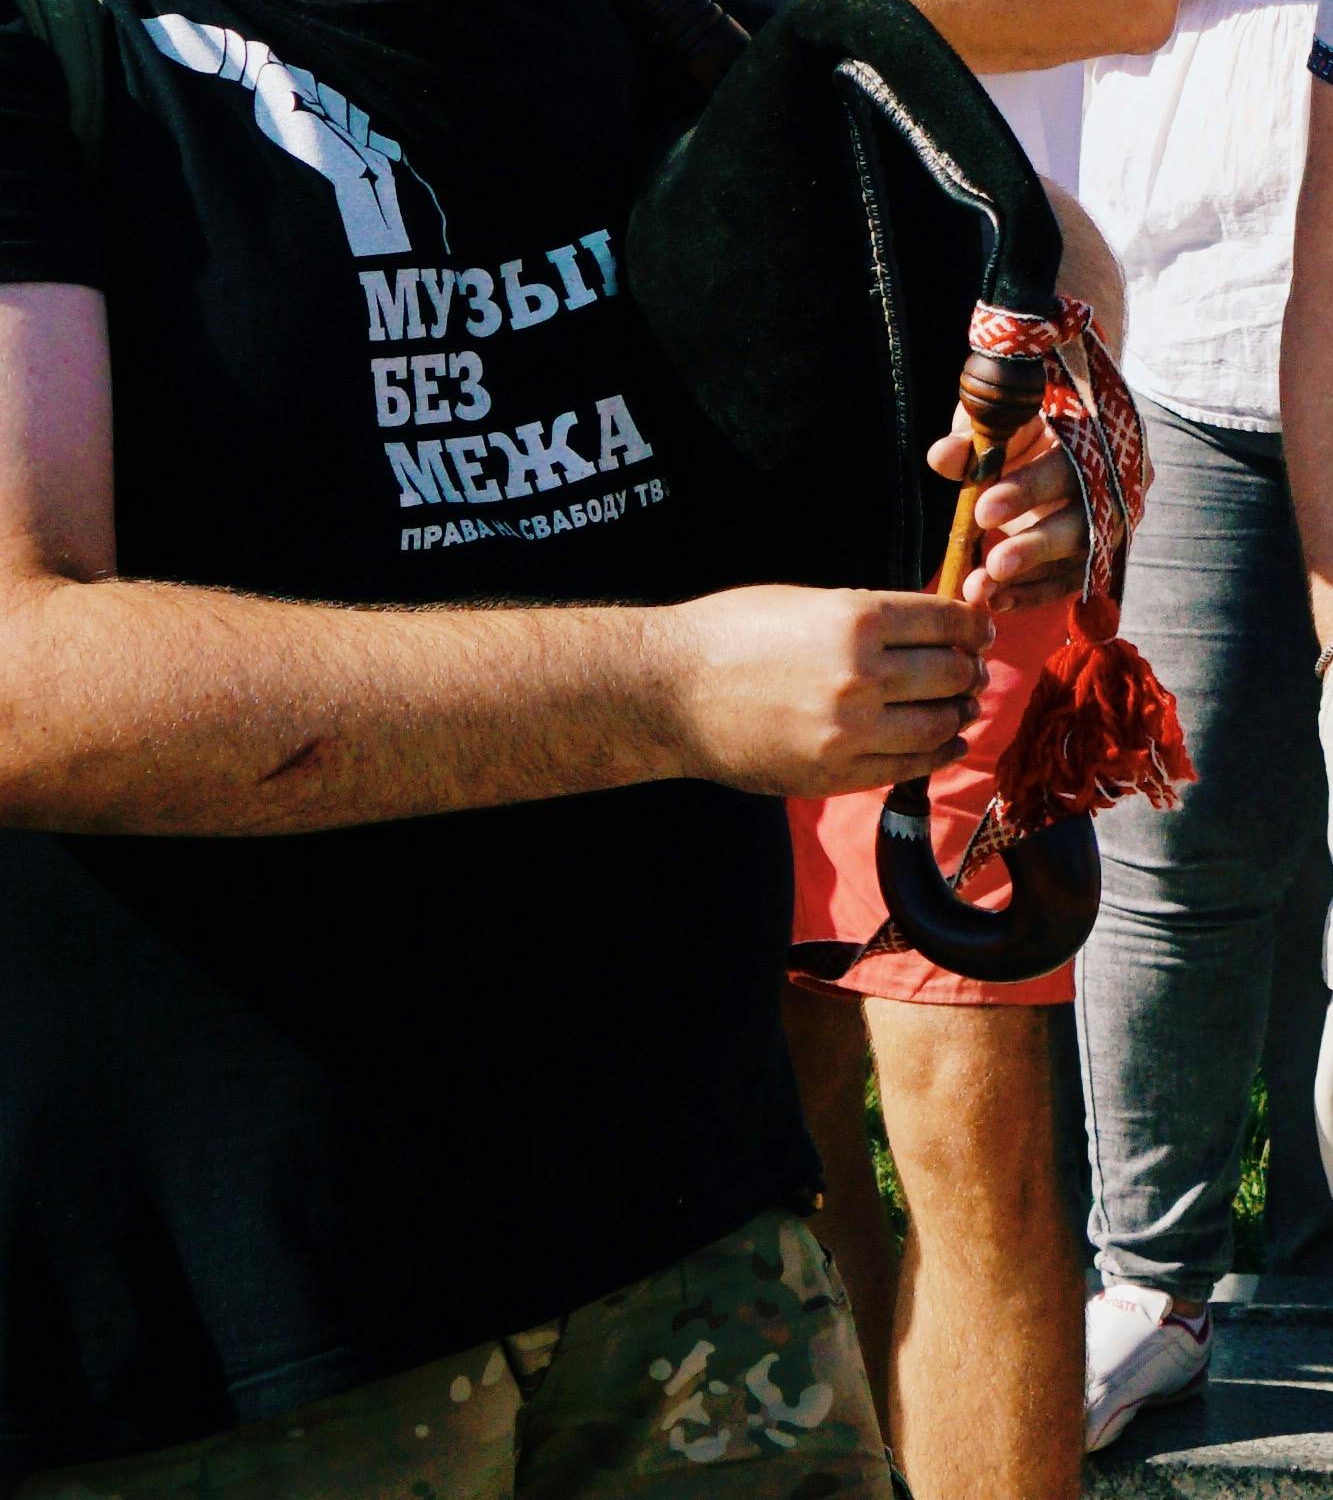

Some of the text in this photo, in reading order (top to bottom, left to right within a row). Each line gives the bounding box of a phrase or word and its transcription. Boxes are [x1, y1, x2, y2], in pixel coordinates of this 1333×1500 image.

[370, 350, 492, 428] БЕЗ
[400, 518, 496, 551] ПРАВА
[519, 489, 627, 542] СВАБОДУ
